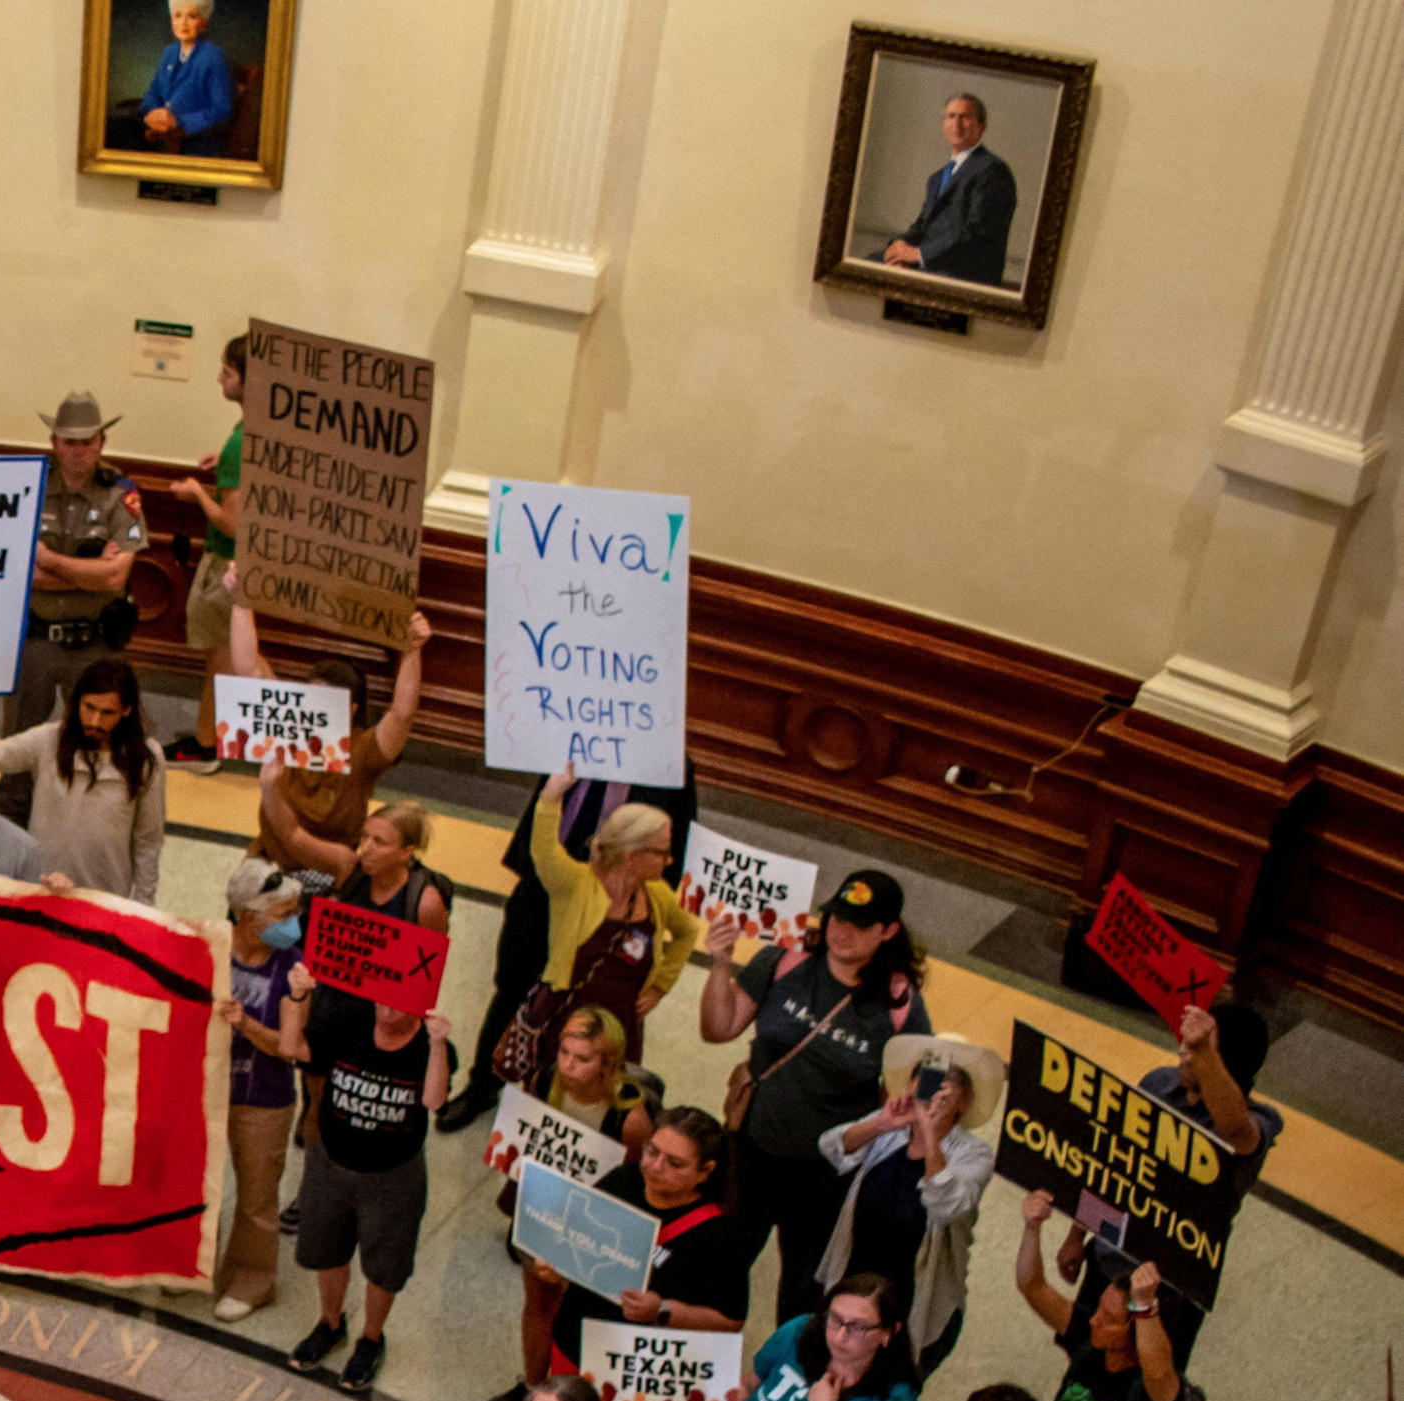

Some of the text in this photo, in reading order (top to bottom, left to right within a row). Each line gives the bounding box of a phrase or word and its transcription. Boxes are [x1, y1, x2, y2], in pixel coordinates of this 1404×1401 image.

[250, 330, 431, 400] WE THE PEOPLE
[269, 382, 419, 458] DEMAND
[243, 433, 417, 515] INDEPENDENT
[243, 483, 417, 555] NON-PARTISAN
[559, 579, 623, 617] the
[262, 688, 304, 707] PUT
[526, 684, 653, 730] RIGHTS
[238, 702, 328, 728] TEXANS
[252, 720, 314, 742] FIRST
[570, 732, 623, 768] ACT
[723, 848, 767, 875] PUT
[702, 858, 788, 900] TEXANS
[709, 884, 769, 912] FIRST
[319, 920, 387, 949] LETTING
[322, 908, 400, 940] ABBOTT'S
[318, 932, 373, 958] TRUMP
[314, 962, 361, 988] TEXAS
[316, 945, 403, 982] TAKE OVER
[1040, 1040, 1220, 1183] DEFEND
[1089, 1120, 1157, 1194] THE
[1005, 1111, 1222, 1270] CONSTITUTION
[634, 1336, 686, 1357] PUT
[606, 1352, 713, 1381] TEXANS
[621, 1375, 695, 1398] FIRST
